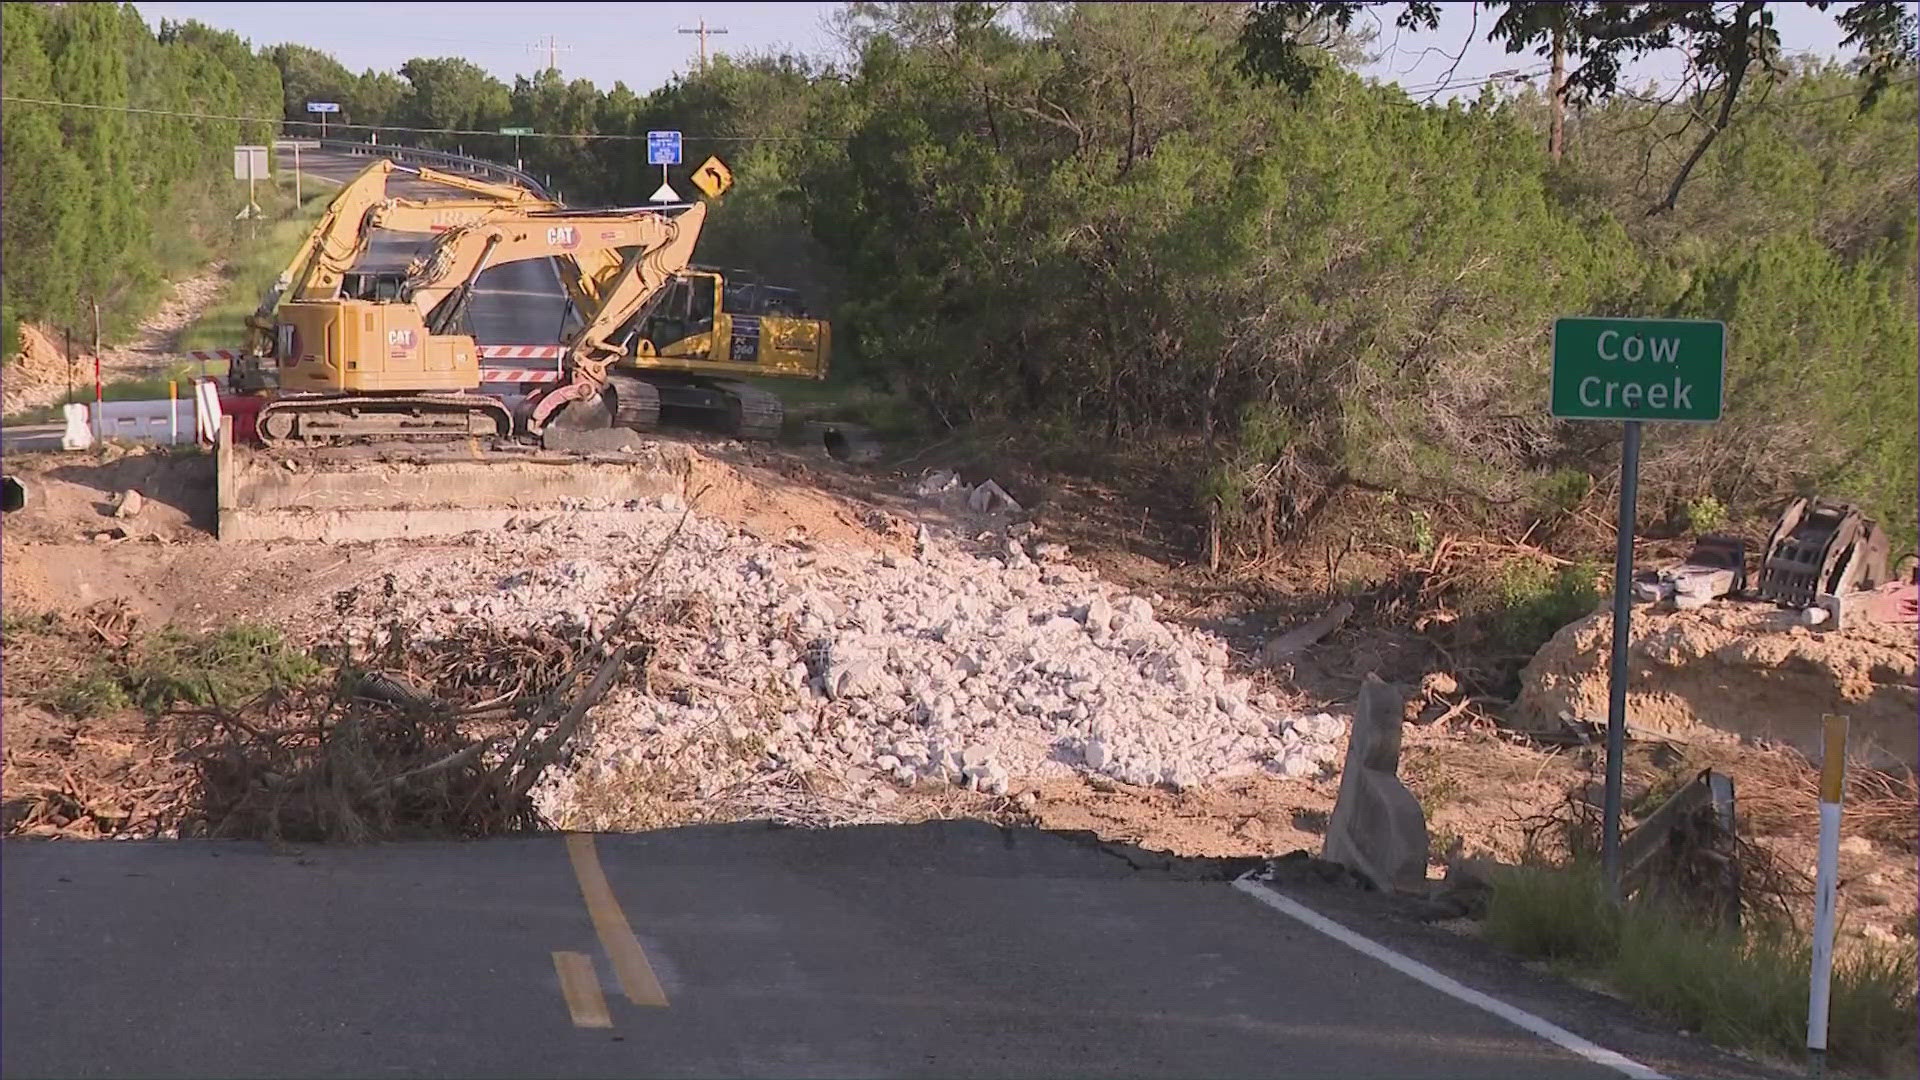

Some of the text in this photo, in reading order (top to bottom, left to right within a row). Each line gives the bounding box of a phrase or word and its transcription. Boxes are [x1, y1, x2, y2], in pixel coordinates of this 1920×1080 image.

[547, 227, 573, 245] CAT
[388, 329, 411, 346] CAT
[1597, 330, 1680, 362] Cow
[1579, 376, 1692, 409] Creek
